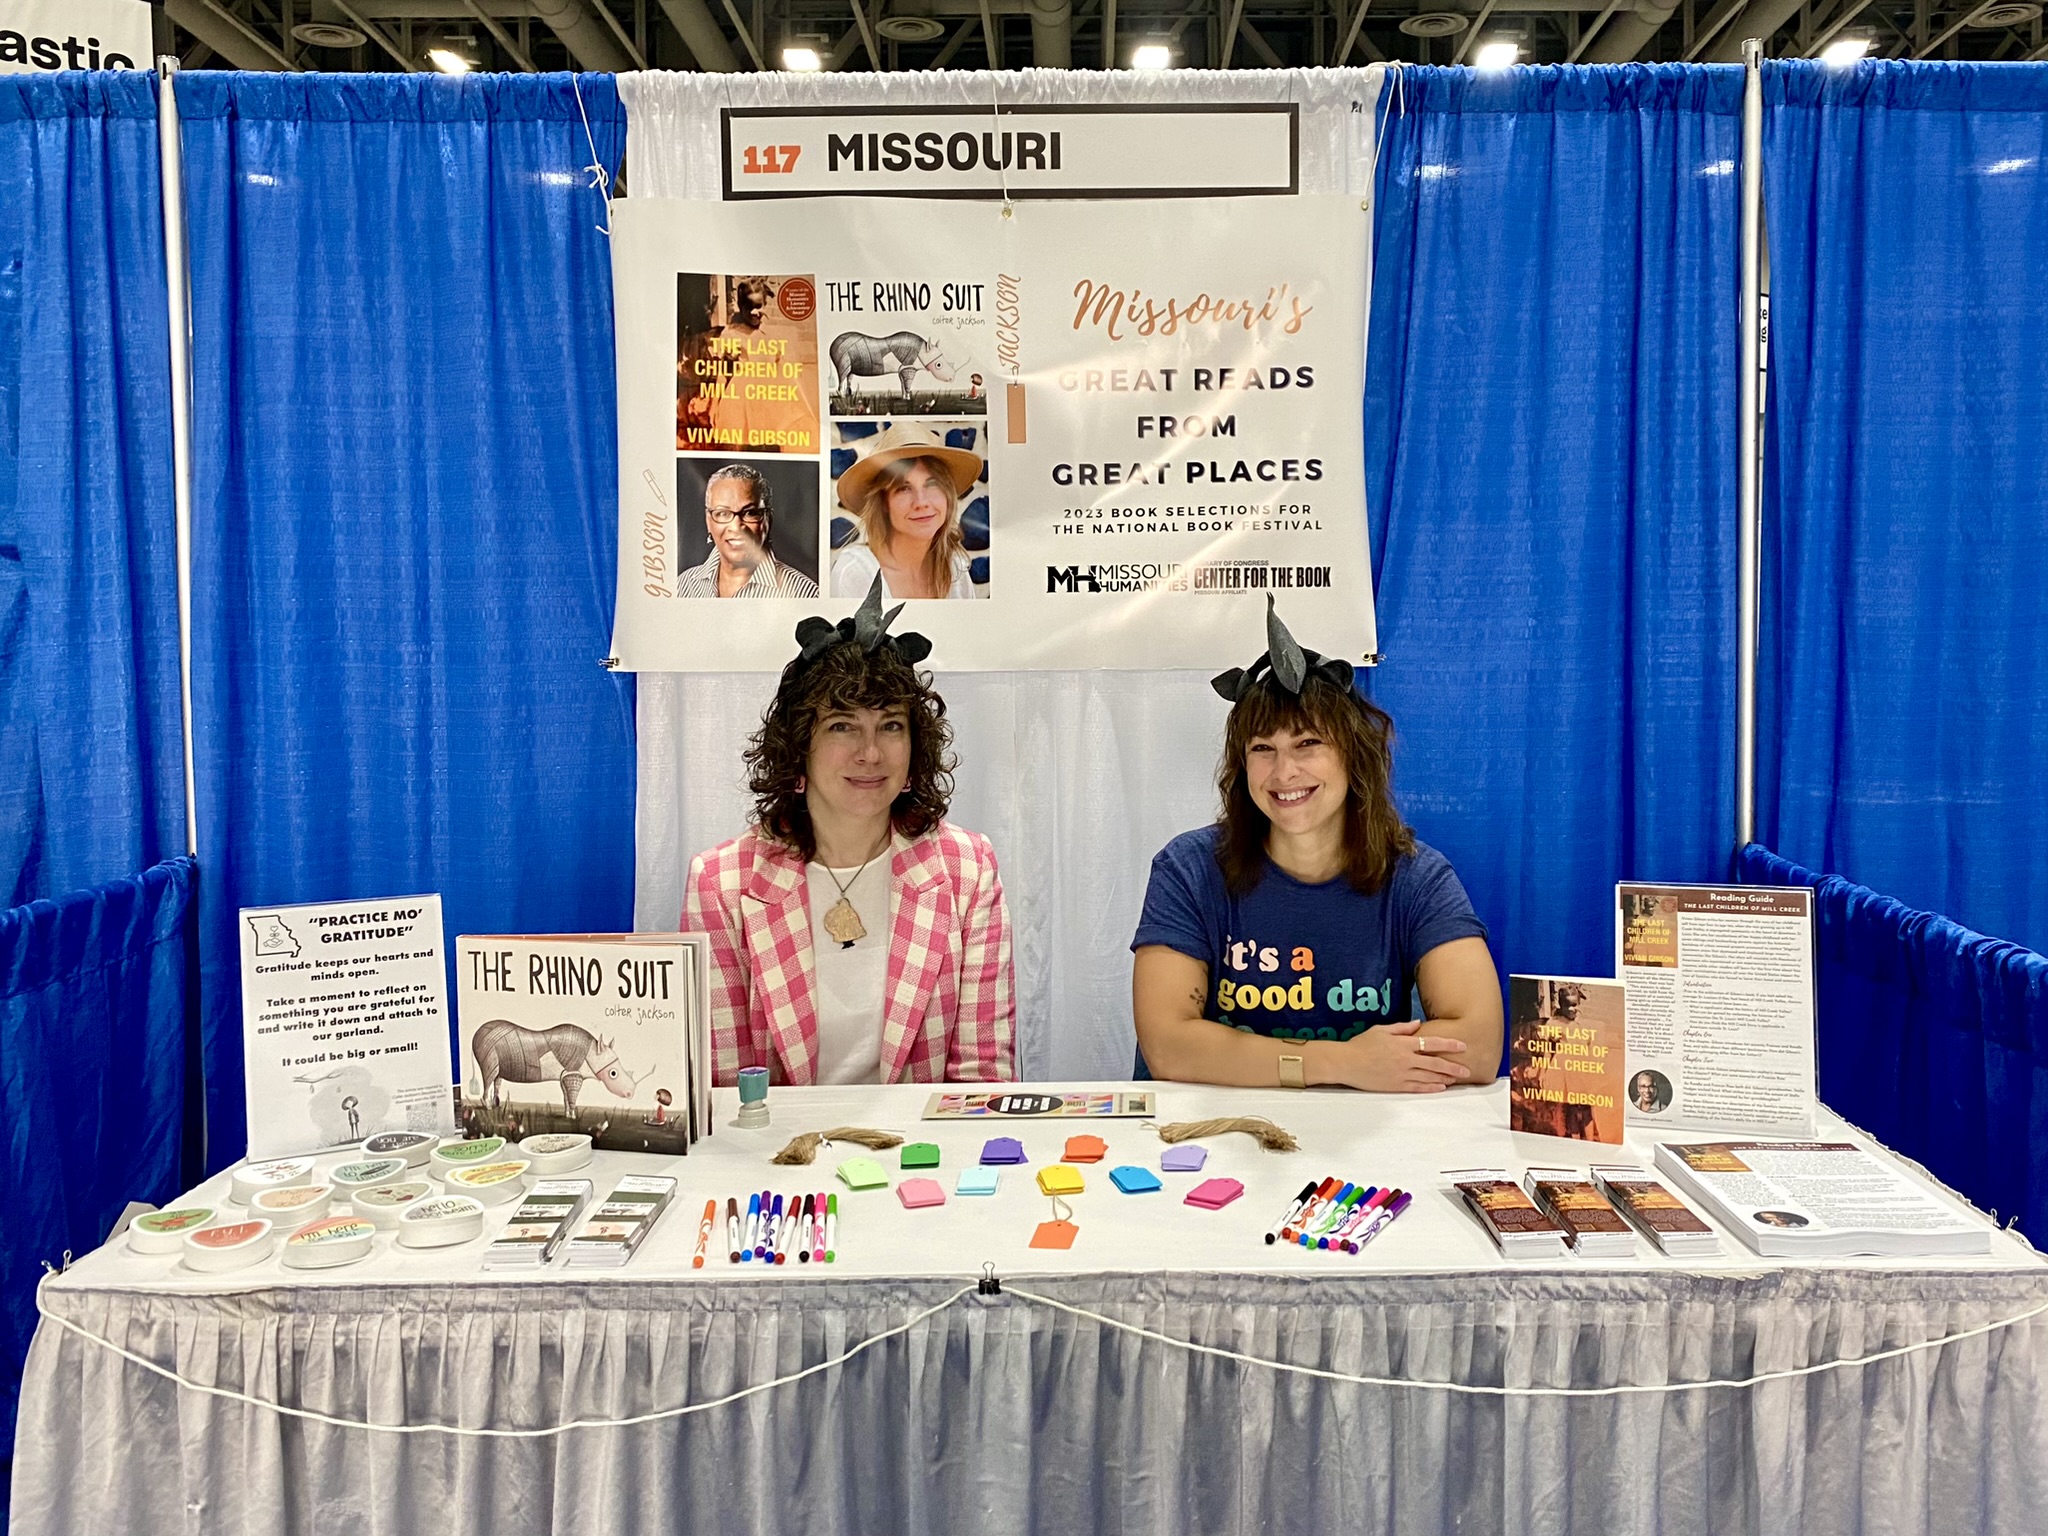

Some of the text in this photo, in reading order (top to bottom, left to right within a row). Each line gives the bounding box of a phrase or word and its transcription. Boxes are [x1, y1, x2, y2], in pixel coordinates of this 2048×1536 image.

[743, 132, 1062, 174] 117 MISSOURI
[825, 281, 863, 312] THE
[873, 282, 931, 312] RHINO
[942, 283, 985, 312] SUIT
[996, 273, 1021, 369] JACKSON
[1072, 279, 1314, 341] Missouri's
[710, 337, 788, 356] THE LAST
[694, 359, 804, 378] CHILDREN OF
[1058, 366, 1315, 393] GREAT READS
[699, 382, 799, 401] MILL CREEK
[686, 427, 811, 447] VIVIAN GIBSON
[1137, 414, 1236, 439] FROM
[1052, 459, 1324, 486] GREAT PLACES
[1063, 504, 1312, 519] 2023 BOOK SELECTIONS FOR
[1053, 519, 1323, 535] THE NATIONAL BOOK FESTIVAL
[1233, 559, 1270, 567] CONGRESS
[1100, 580, 1189, 593] HUMANIIES
[1194, 566, 1332, 589] CENTER FOR THE BOOK
[1710, 893, 1775, 904] Reading Guide
[1648, 919, 1665, 927] LAST
[255, 948, 434, 975] Gratitude keeps our hearts and
[1223, 934, 1315, 973] it's a
[311, 969, 379, 982] minds open.
[467, 950, 674, 1000] THE RHINO SUIT
[266, 983, 427, 1009] Take a moment to reflect on
[1217, 975, 1392, 1017] good day
[258, 994, 436, 1022] something you are grateful for
[257, 1006, 438, 1035] and write it down and attach to
[312, 1026, 384, 1042] our garland.
[1538, 1024, 1598, 1041] THE LAST
[281, 1042, 419, 1068] It could be big or small!
[1527, 1040, 1609, 1059] CHILDREN OF
[1531, 1056, 1605, 1075] MILL CREEK
[1522, 1087, 1614, 1109] VIVIAN GIBSON
